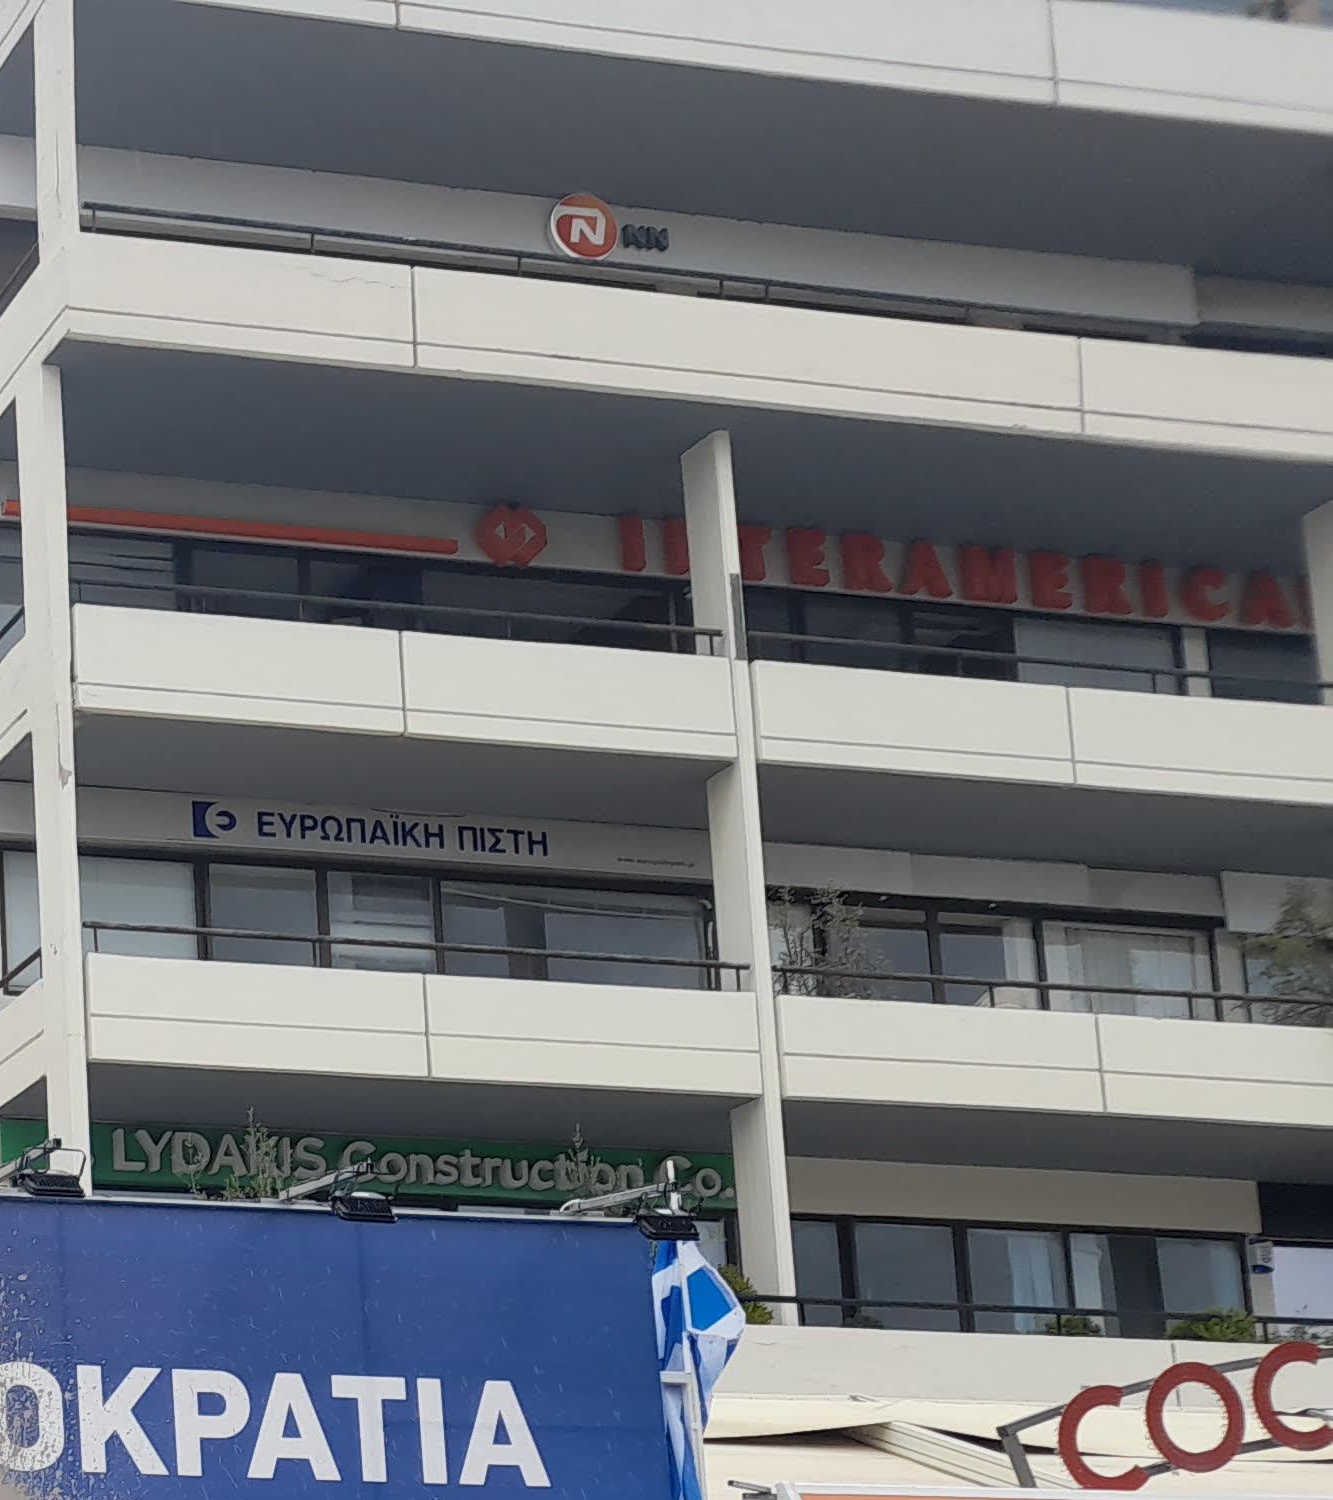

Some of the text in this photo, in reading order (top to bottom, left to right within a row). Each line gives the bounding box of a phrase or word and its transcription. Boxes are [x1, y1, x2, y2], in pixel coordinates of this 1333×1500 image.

[618, 514, 1314, 631] ITERAMERICA
[256, 810, 549, 857] ΕΥΡΩΠΑΪΚΗ ΠΙΣΤΗ
